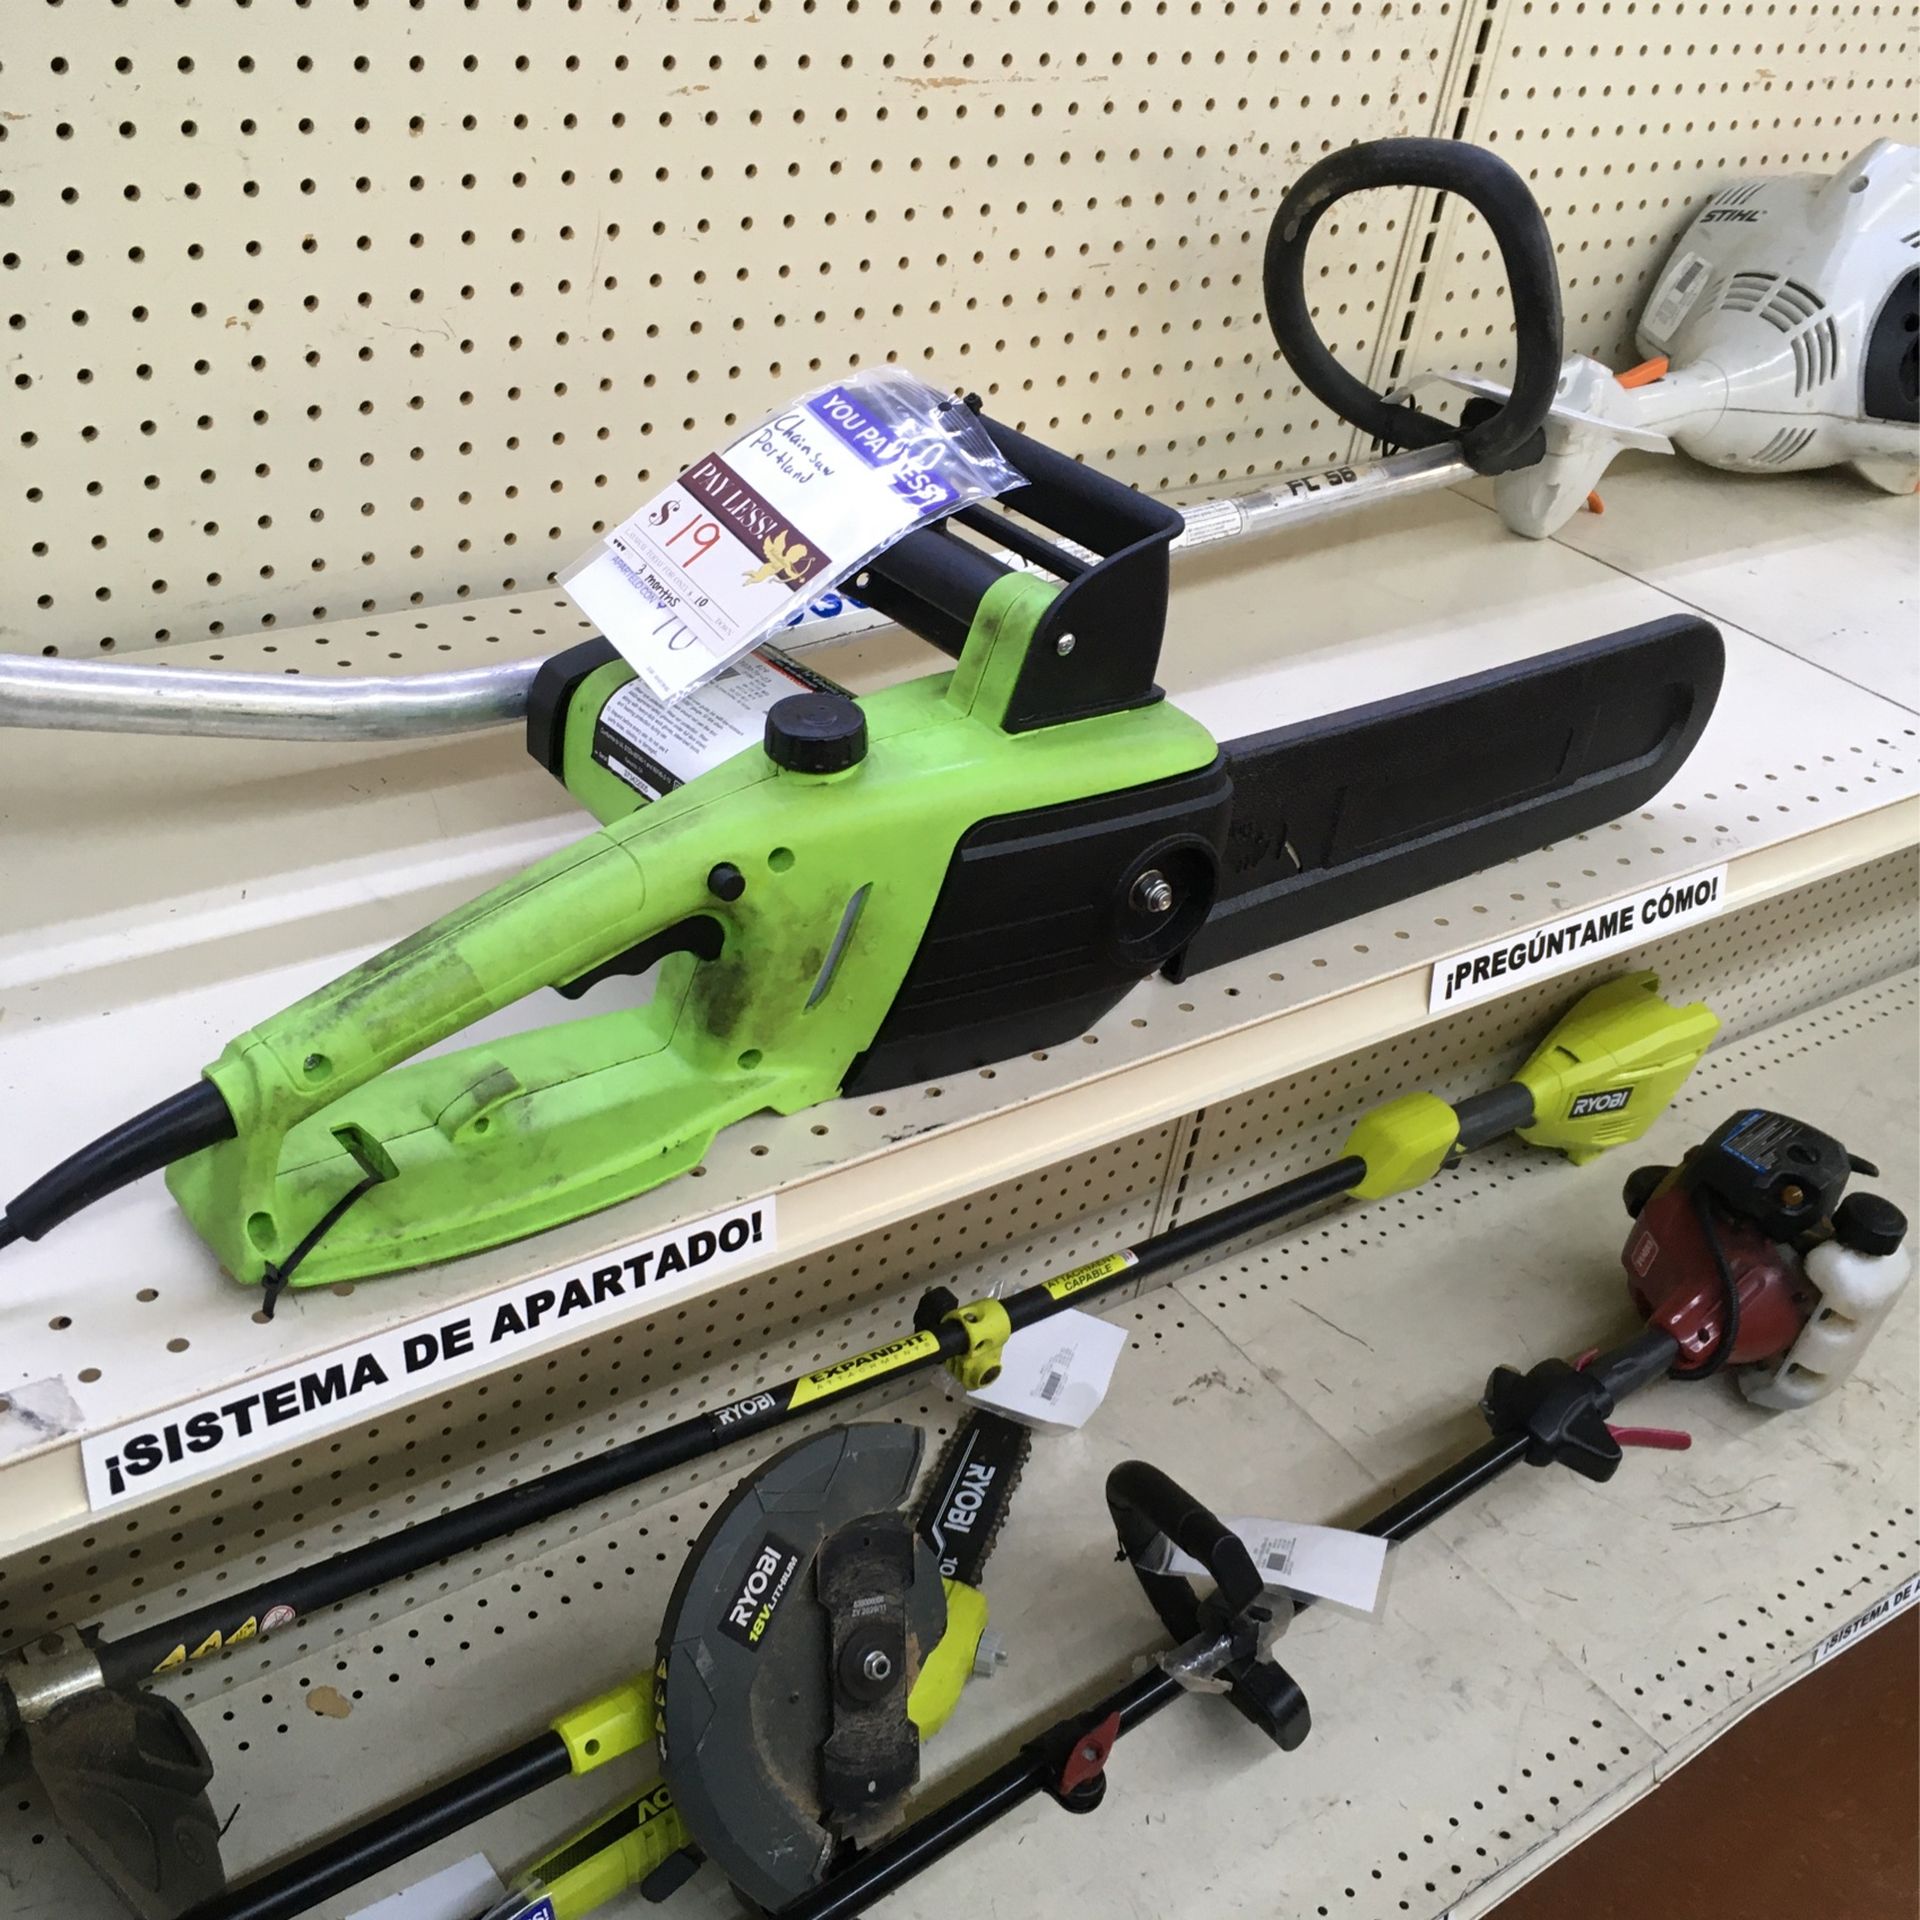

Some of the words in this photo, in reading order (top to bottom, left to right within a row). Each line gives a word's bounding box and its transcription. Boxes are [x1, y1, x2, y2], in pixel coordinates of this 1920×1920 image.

[1700, 209, 1759, 223] STIHL
[822, 394, 866, 431] YOU
[692, 462, 729, 497] PAY
[722, 489, 778, 540] LESS!
[1325, 466, 1357, 486] 56
[648, 499, 680, 527] $
[665, 513, 720, 568] 19
[644, 574, 681, 608] months
[1445, 906, 1634, 1000] ¡PREGÚNTAME
[1641, 876, 1718, 925] CÓMO!
[1573, 1091, 1628, 1115] RYOBI
[1047, 1253, 1116, 1288] ATTACHMENT
[1064, 1263, 1113, 1291] CAPABLE
[105, 1354, 388, 1495] ¡SISTEMA
[405, 1318, 474, 1374] DE
[490, 1211, 763, 1343] APARTADO!
[714, 1393, 776, 1426] RYOBI
[943, 1463, 996, 1533] RYOBI
[729, 1545, 782, 1627] RYOBI
[749, 1603, 771, 1642] 18V
[767, 1555, 798, 1610] LITHIUM
[1823, 1600, 1889, 1654] ¡SISTEMA
[1893, 1585, 1912, 1606] DE
